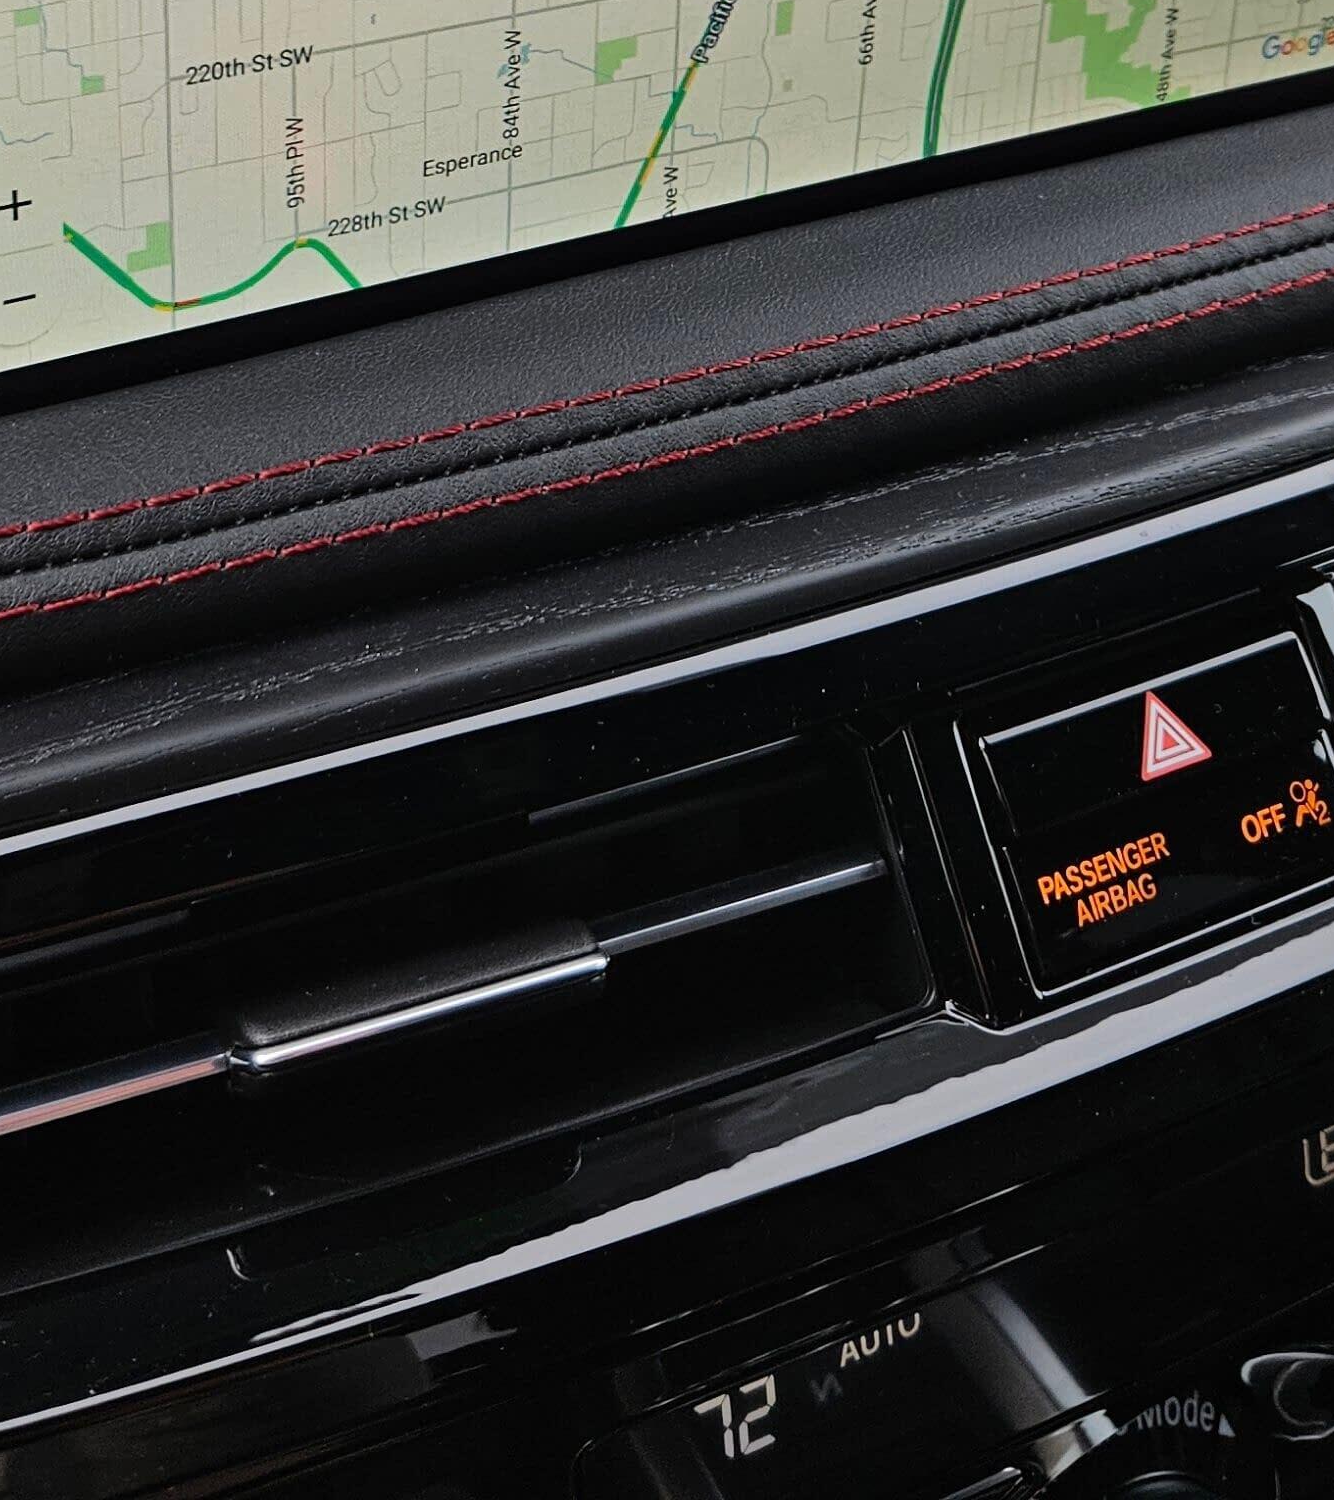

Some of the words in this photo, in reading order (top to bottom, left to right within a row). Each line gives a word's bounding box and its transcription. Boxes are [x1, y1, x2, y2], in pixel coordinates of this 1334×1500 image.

[1164, 7, 1178, 23] W
[505, 30, 522, 50] W
[858, 25, 875, 65] 66th
[1161, 25, 1176, 58] Ave
[186, 58, 247, 86] 220th
[251, 52, 275, 75] St
[279, 46, 314, 70] SW
[504, 53, 520, 94] Ave
[1155, 59, 1172, 101] 48th
[285, 118, 303, 138] W
[503, 96, 521, 140] 84th
[285, 140, 304, 160] Pl
[423, 144, 523, 177] Esperance
[286, 164, 305, 208] 95th
[664, 166, 678, 185] W
[327, 214, 382, 237] 228th
[387, 207, 408, 228] St
[412, 196, 446, 222] SW
[1241, 804, 1286, 844] OFF
[1038, 832, 1170, 905] PASSENGER
[1076, 874, 1158, 928] AIRBAG
[694, 1374, 776, 1458] 72
